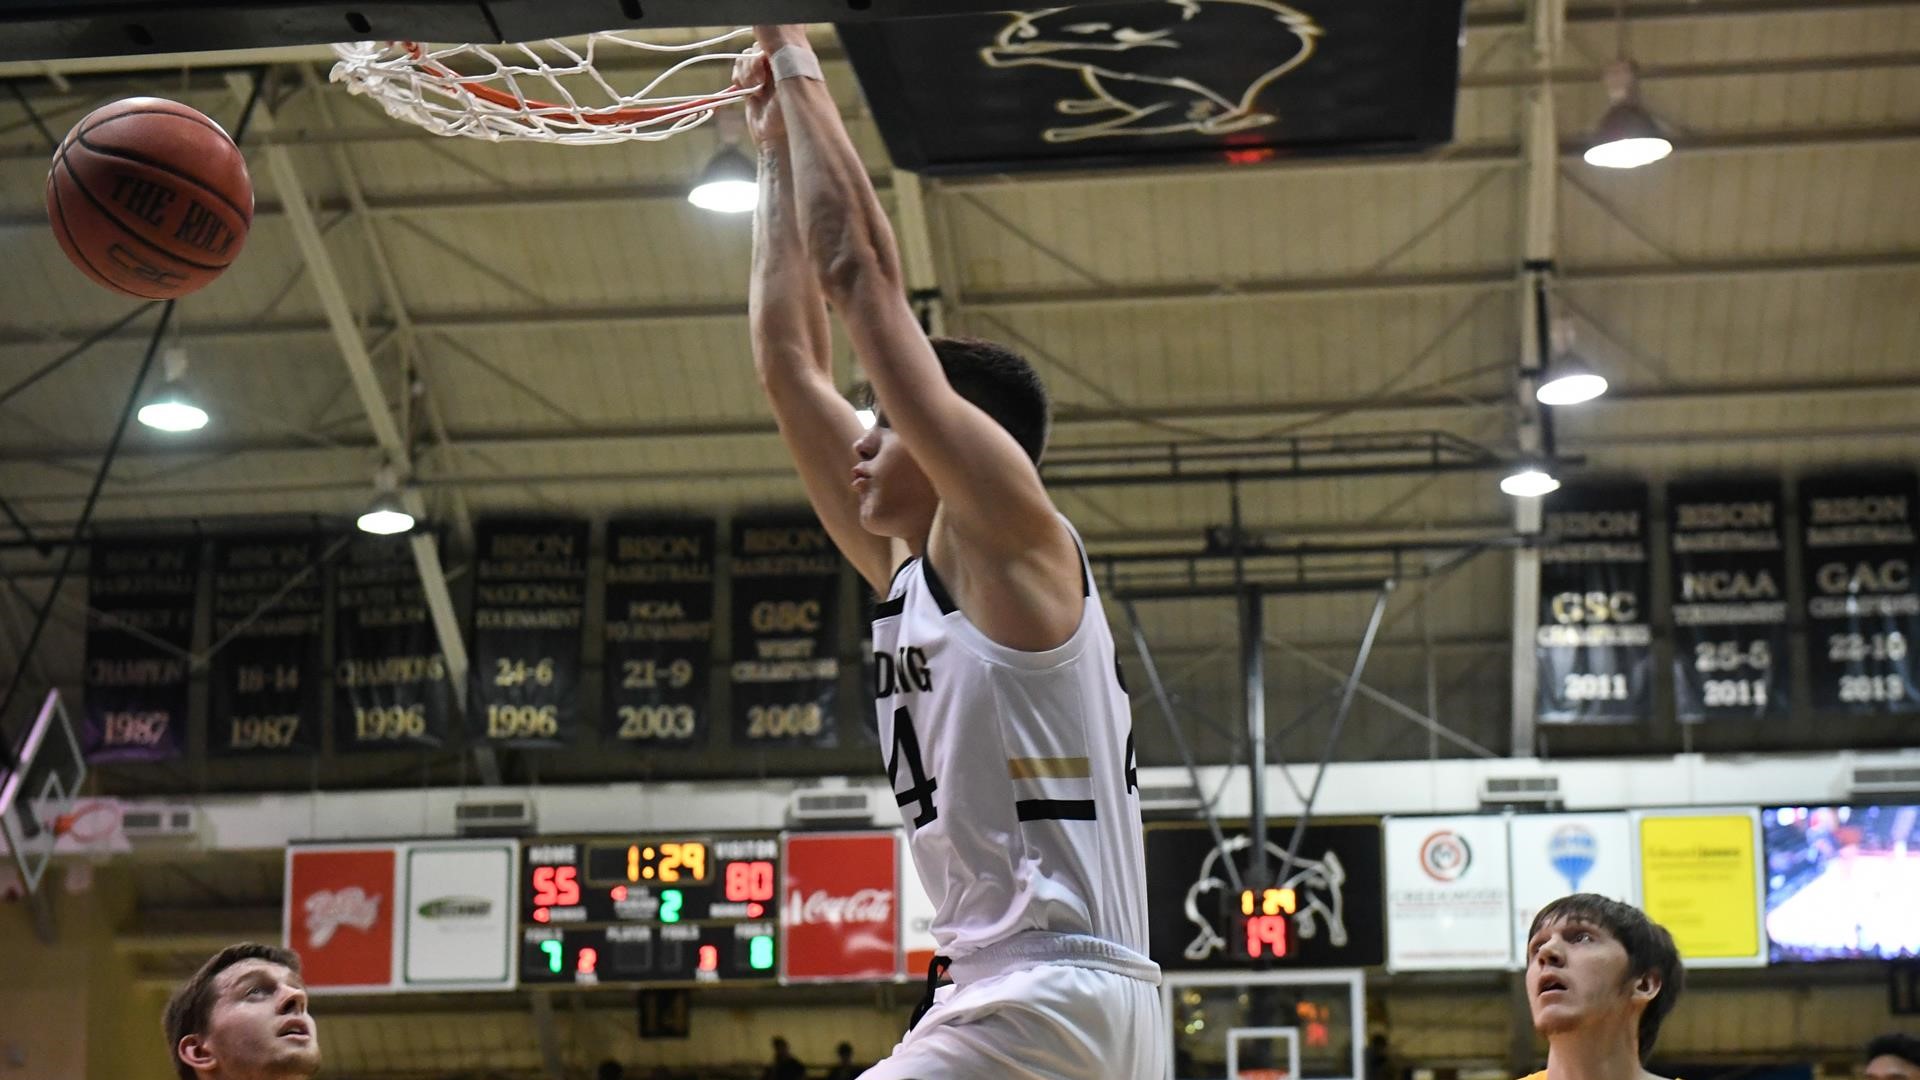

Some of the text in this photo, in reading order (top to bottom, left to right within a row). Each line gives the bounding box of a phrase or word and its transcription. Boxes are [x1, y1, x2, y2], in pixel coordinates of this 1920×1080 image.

[112, 175, 235, 255] THE ROCK
[479, 582, 582, 603] NATIONAL
[1682, 568, 1778, 599] NCAA
[1815, 559, 1910, 593] GAC
[1552, 591, 1638, 623] GSC
[494, 658, 554, 687] 24-6
[622, 658, 694, 690] 21-9
[1564, 673, 1628, 701] 2011
[1703, 679, 1768, 706] 2011
[104, 711, 169, 744] 1987
[231, 714, 300, 747] 1987
[356, 703, 427, 741] 1996
[487, 703, 559, 740] 1996
[617, 703, 697, 741] 2003
[626, 842, 705, 882] 1:29
[533, 866, 580, 906] 55
[725, 861, 774, 902] 80
[659, 889, 683, 923] 2
[1246, 915, 1287, 959] 19
[540, 940, 563, 974] 7
